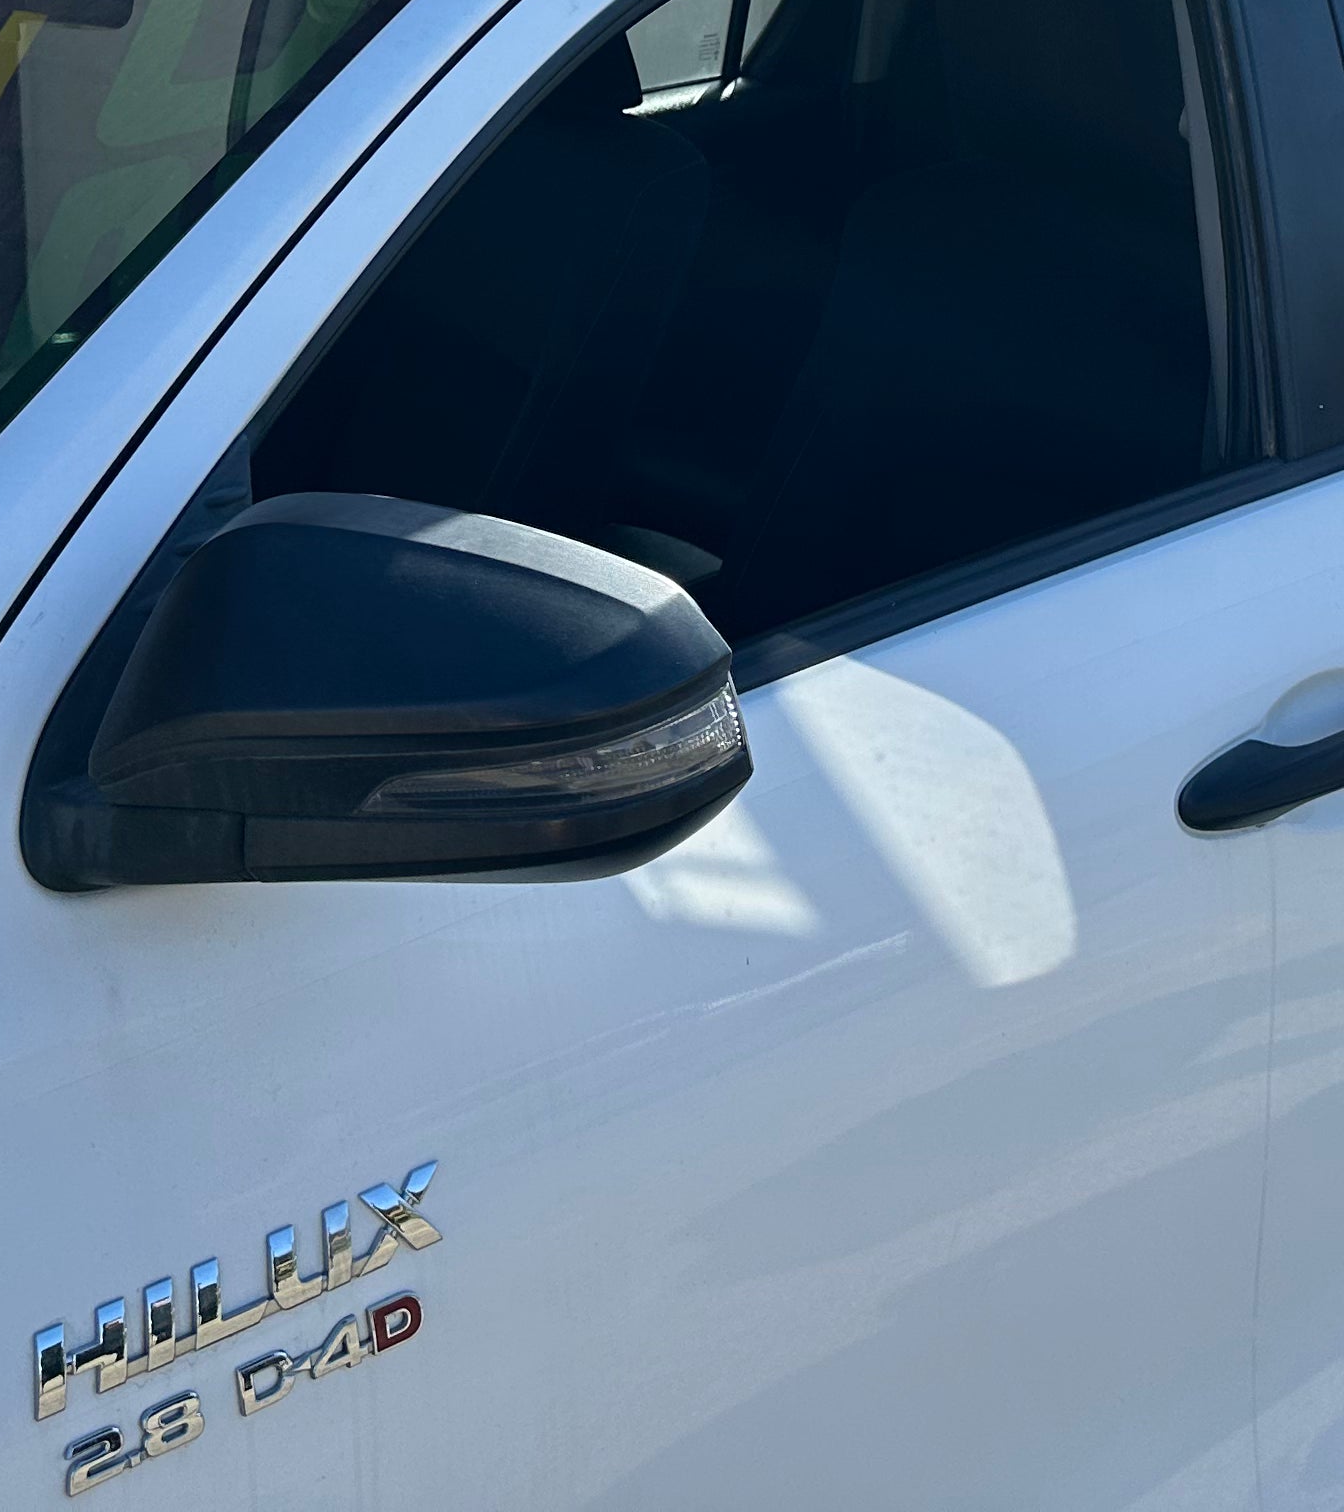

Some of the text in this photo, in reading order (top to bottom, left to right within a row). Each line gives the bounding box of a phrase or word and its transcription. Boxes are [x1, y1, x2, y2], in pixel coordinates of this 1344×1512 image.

[33, 1159, 444, 1422] HILUX
[64, 1290, 425, 1497] 2.8 D-4D
